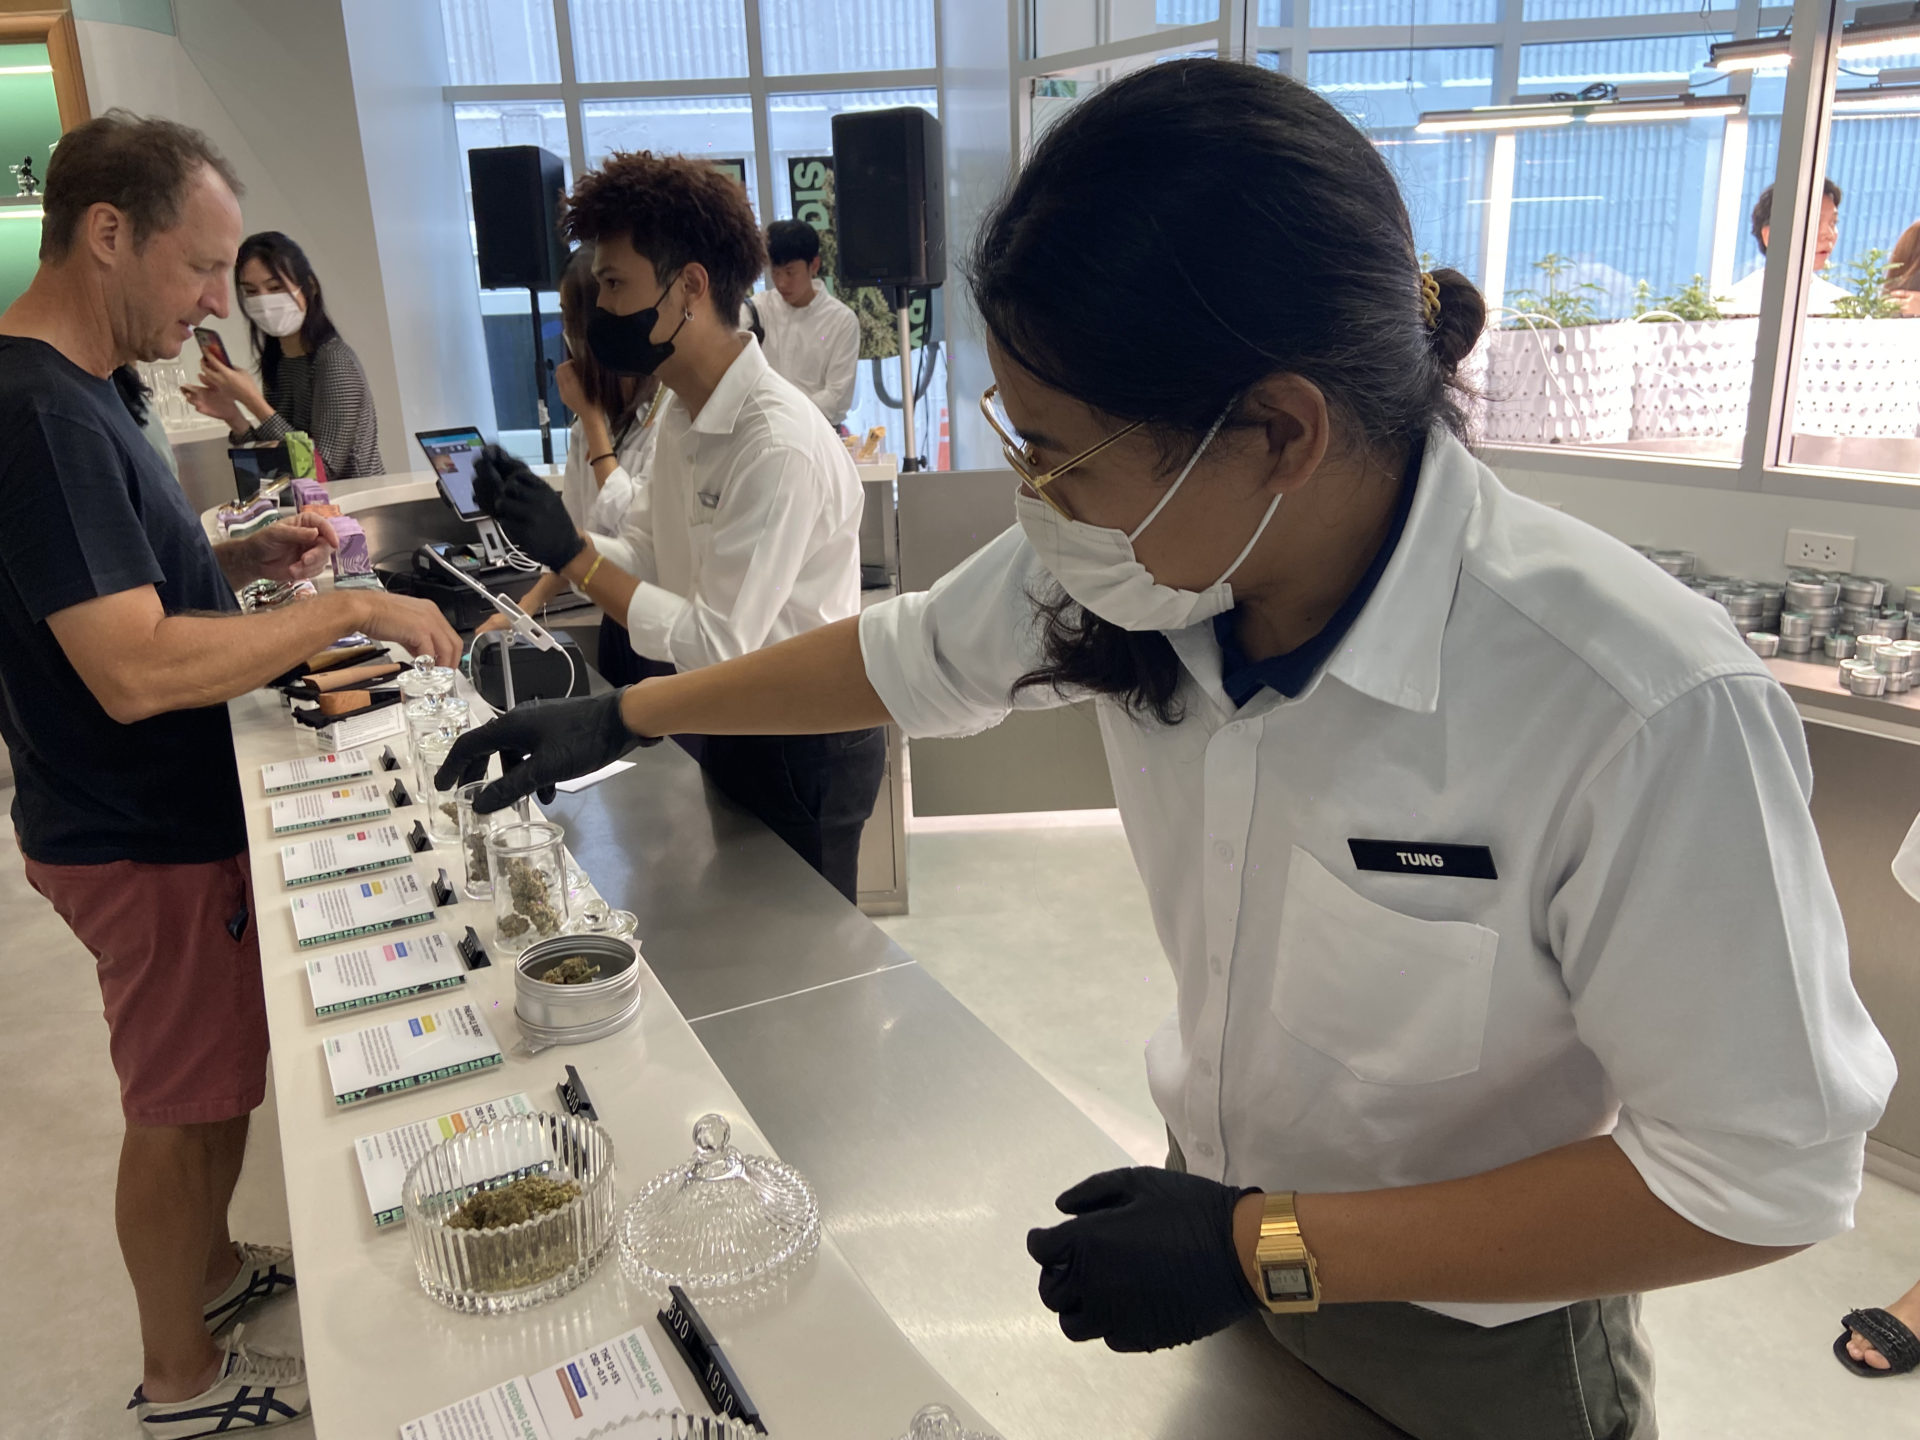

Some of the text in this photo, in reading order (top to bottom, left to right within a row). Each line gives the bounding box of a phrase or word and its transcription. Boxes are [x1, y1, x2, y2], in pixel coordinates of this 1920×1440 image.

[1396, 852, 1444, 867] TUNG
[299, 912, 431, 947] DISPENSARY THE
[316, 975, 461, 1016] DISPENSARY THE
[377, 1076, 416, 1094] THE
[589, 1351, 600, 1366] CBD
[600, 1347, 611, 1361] THC
[627, 1333, 662, 1395] WEDDING CAKE
[505, 1381, 528, 1420] WEDDING
[706, 1363, 733, 1413] 1900
